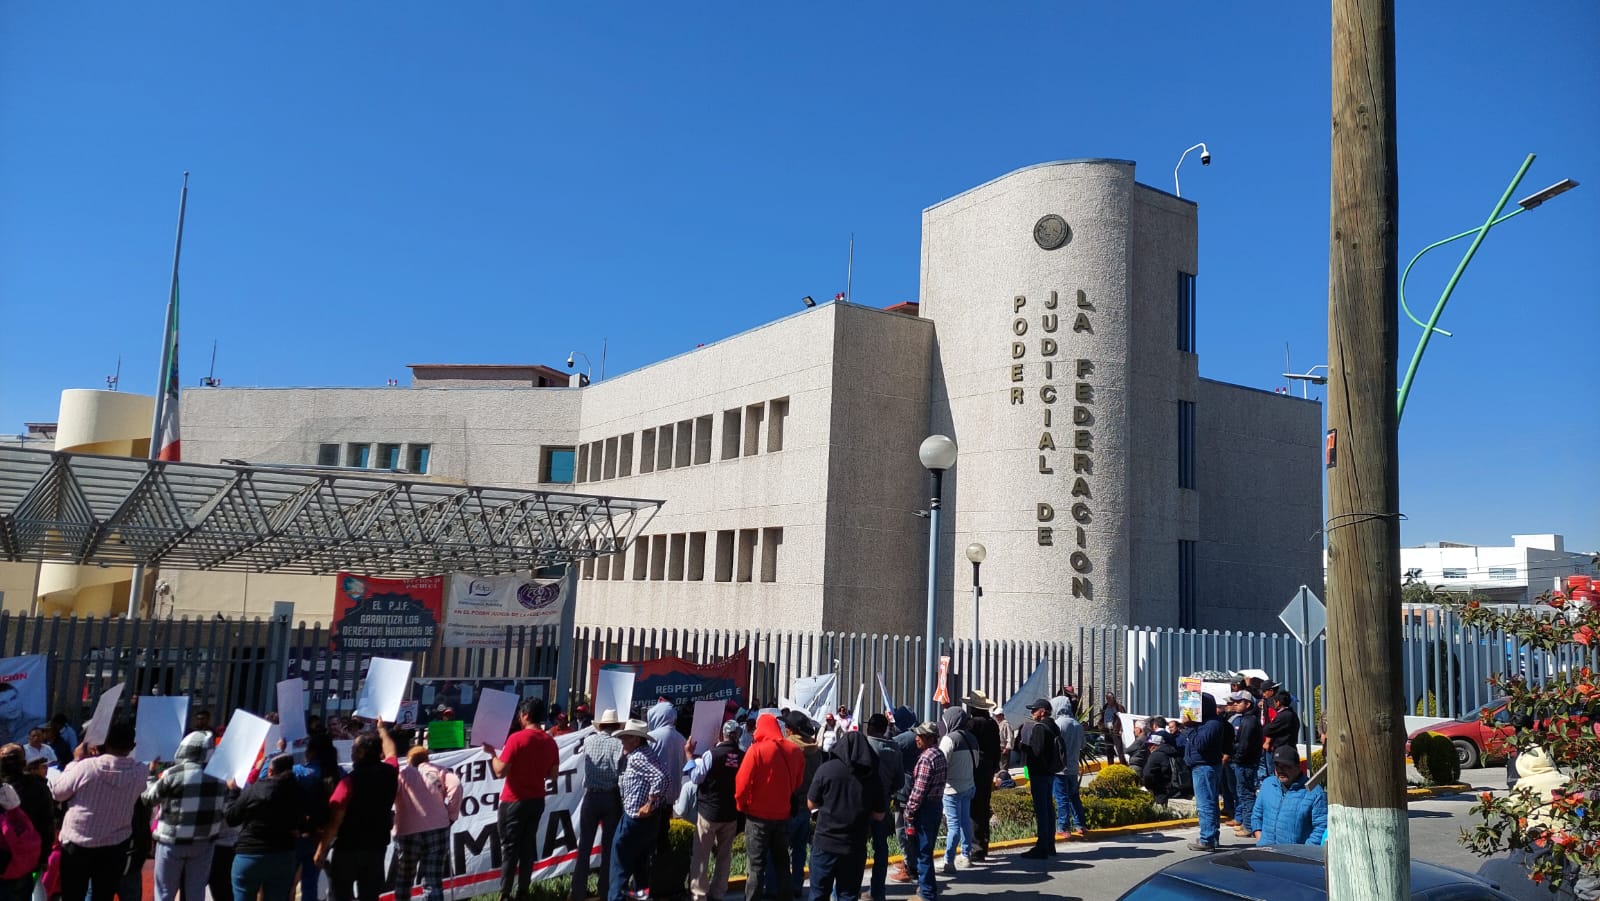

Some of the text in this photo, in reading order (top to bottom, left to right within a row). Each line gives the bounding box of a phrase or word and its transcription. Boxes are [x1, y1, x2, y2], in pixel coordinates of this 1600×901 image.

[1010, 295, 1028, 405] PODER
[1037, 290, 1058, 546] JUDICIAL DE
[1070, 289, 1093, 598] LA FEDERACION
[372, 601, 382, 610] EL
[360, 614, 419, 625] GARANTIZA LOS
[342, 626, 433, 636] DERECHOS HUMANOS DE
[344, 638, 432, 648] TODOS LOS MEXICANOS
[656, 684, 702, 694] RESPETO
